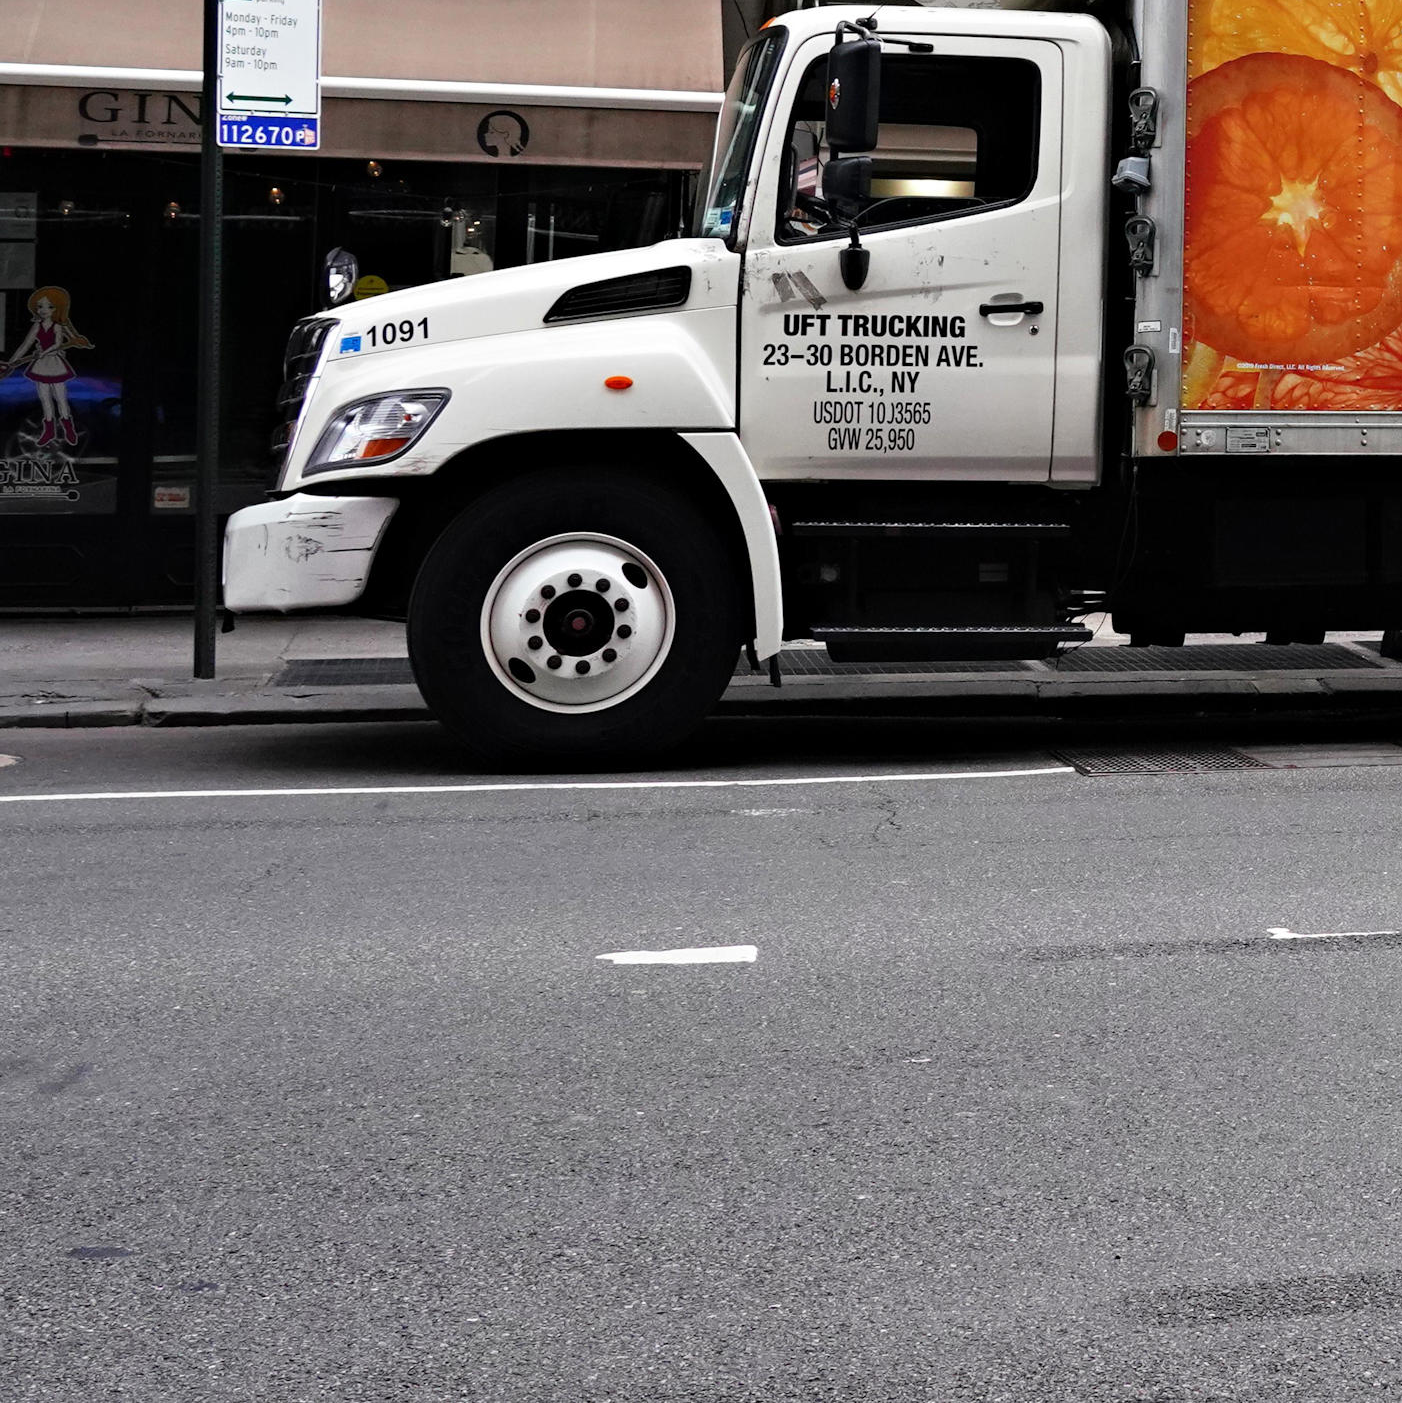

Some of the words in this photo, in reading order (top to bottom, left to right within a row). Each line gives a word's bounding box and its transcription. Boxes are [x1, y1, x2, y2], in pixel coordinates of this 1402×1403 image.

[226, 11, 261, 24] Monday
[270, 15, 298, 27] Friday
[226, 26, 245, 36] 4pm
[255, 27, 278, 38] 10pm
[226, 44, 267, 58] Saturday
[225, 58, 244, 68] 9am
[254, 60, 278, 70] 10pm
[222, 125, 293, 144] 112670
[367, 317, 428, 346] 1091
[784, 314, 830, 336] UFT
[838, 315, 965, 338] TRUCKING
[763, 344, 832, 366] 23-30
[840, 345, 929, 367] BORDEN
[936, 346, 984, 367] AVE.
[826, 371, 884, 396] L.I.C.,
[891, 372, 920, 393] NY
[814, 401, 863, 424] USDOT
[828, 428, 861, 450] GVW
[865, 428, 914, 453] 25,950
